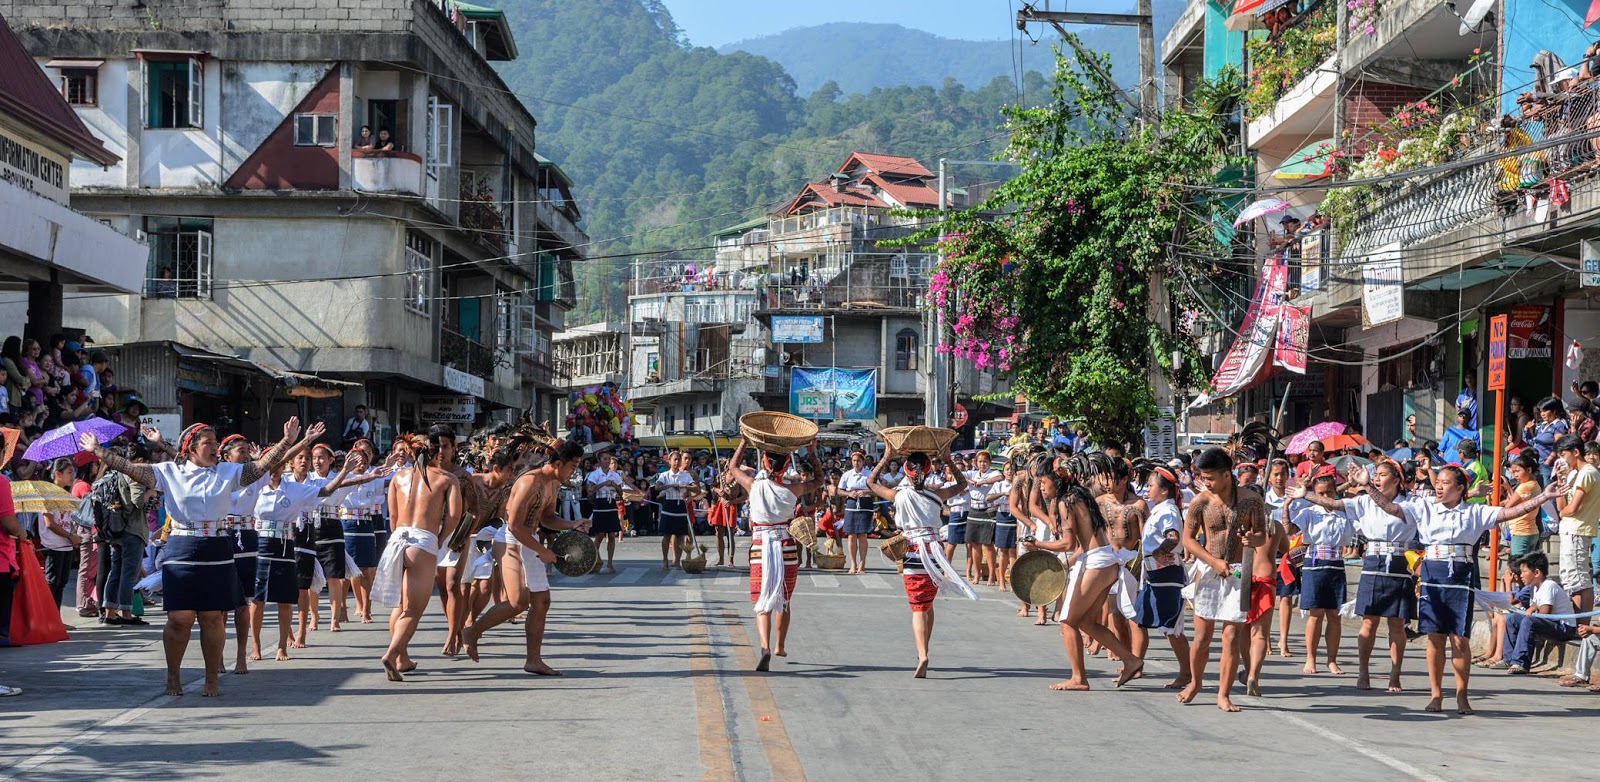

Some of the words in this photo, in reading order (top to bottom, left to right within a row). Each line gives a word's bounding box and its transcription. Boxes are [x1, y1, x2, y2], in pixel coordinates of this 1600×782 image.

[41, 156, 63, 190] CENTER
[1494, 321, 1504, 338] NO
[800, 396, 818, 405] JRS
[422, 412, 472, 420] Restaurant
